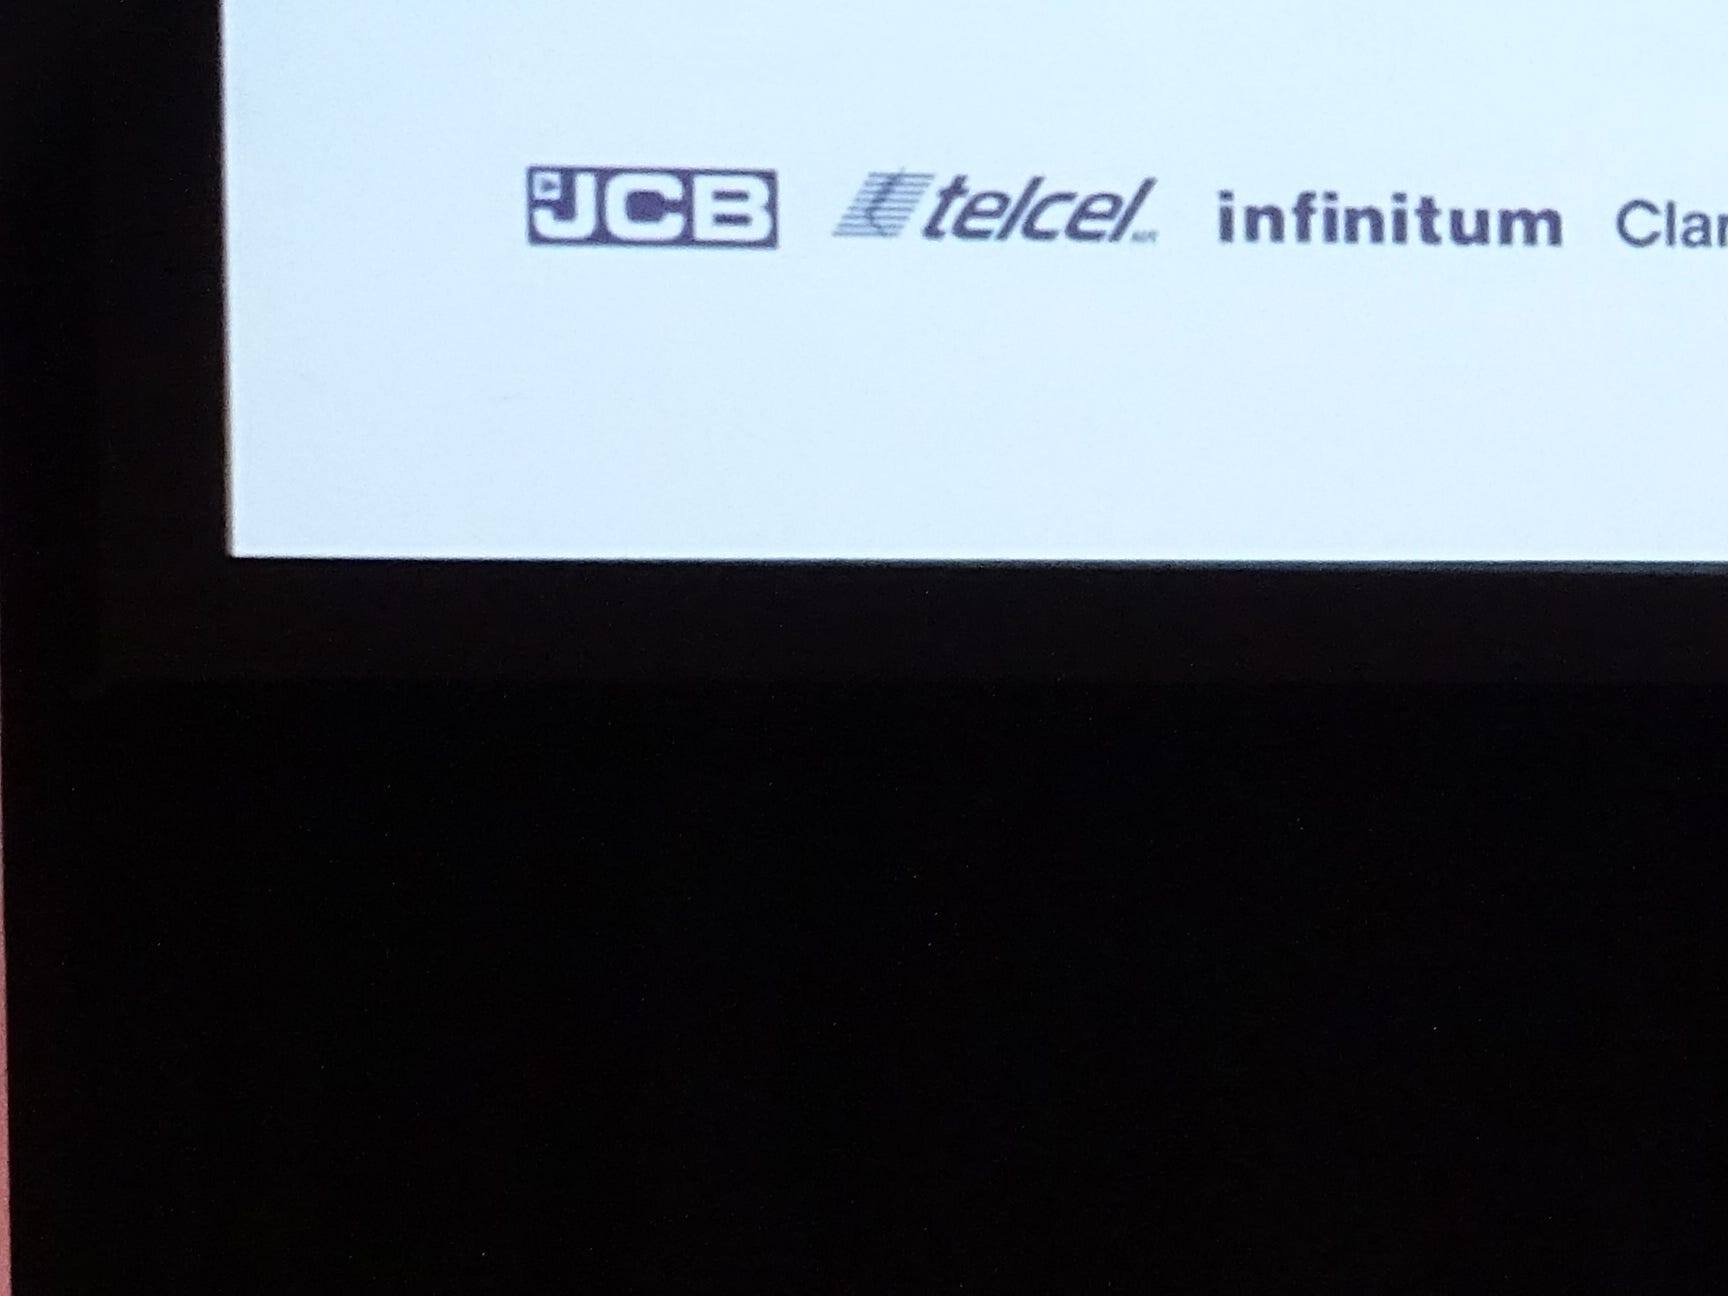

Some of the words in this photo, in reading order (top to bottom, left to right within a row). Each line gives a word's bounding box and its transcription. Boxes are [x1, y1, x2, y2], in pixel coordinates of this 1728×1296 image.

[531, 171, 775, 244] JCB
[921, 176, 1157, 244] telcel
[1218, 190, 1564, 248] infinitum
